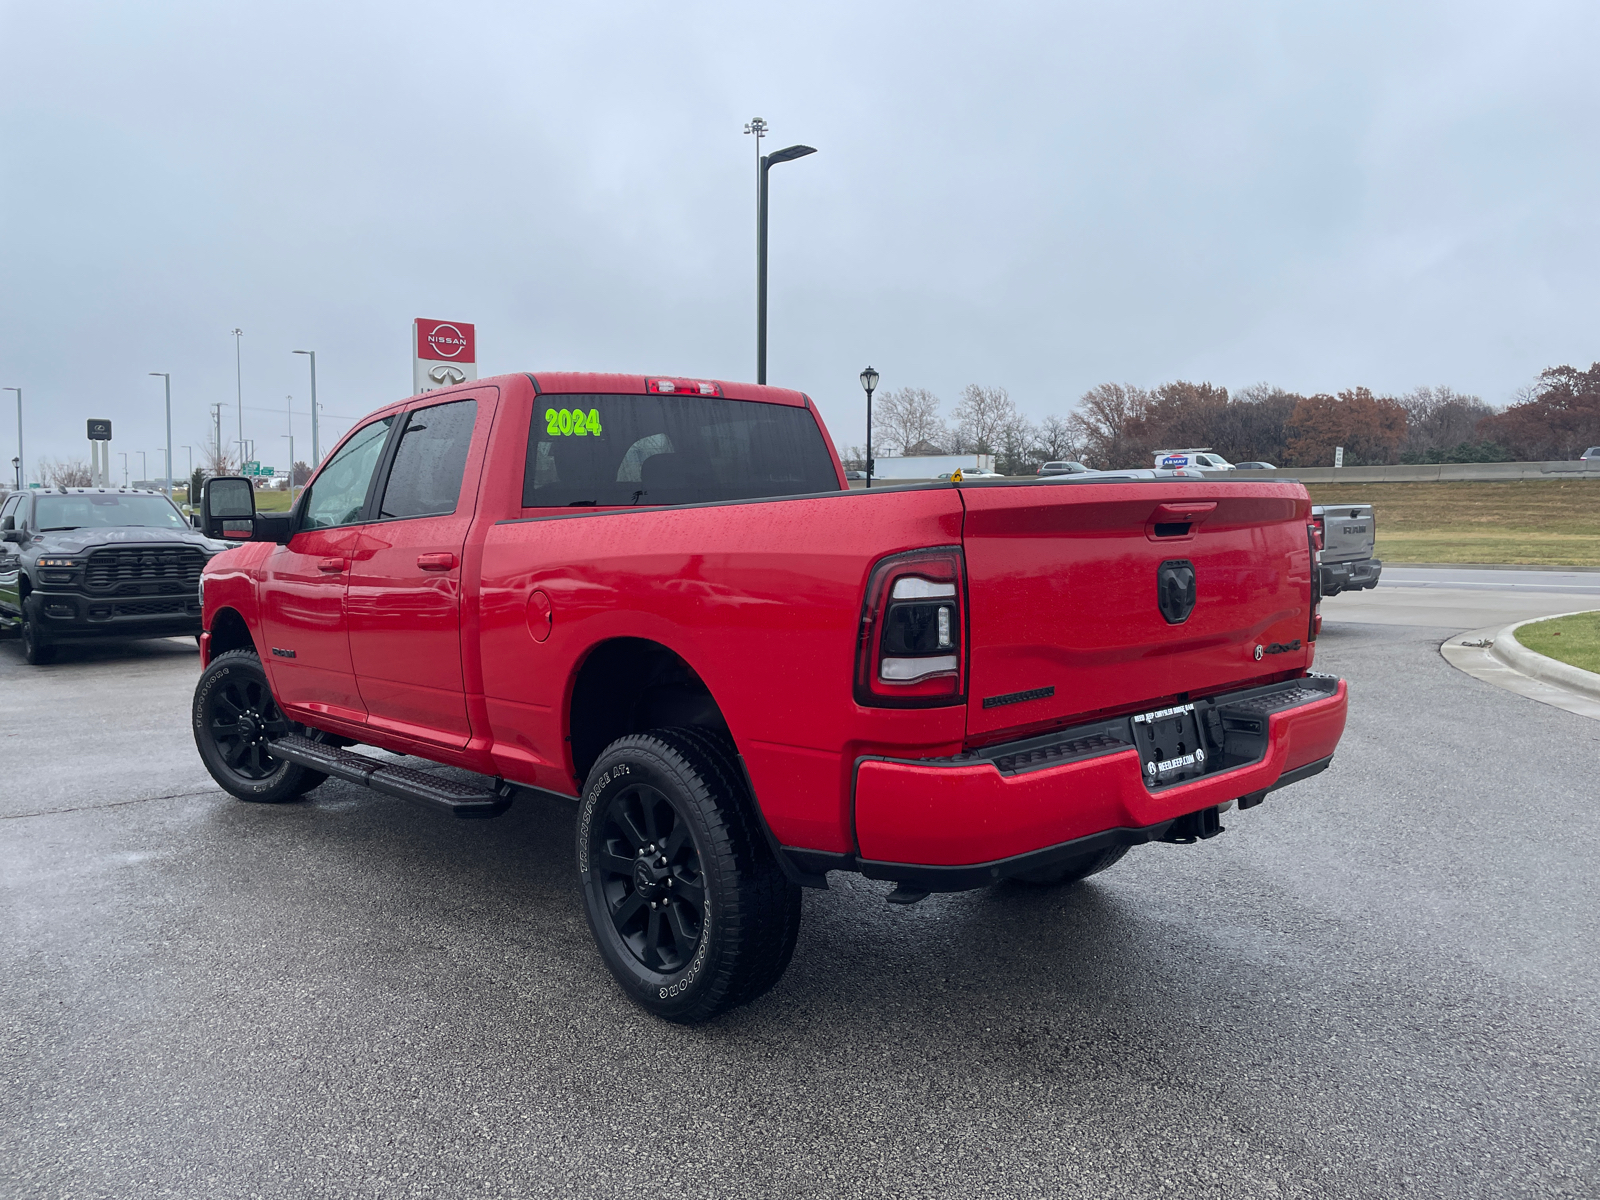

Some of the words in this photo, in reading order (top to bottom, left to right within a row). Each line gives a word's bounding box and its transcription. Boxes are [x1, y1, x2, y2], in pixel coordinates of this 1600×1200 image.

[427, 335, 467, 346] NISSAN
[545, 408, 602, 437] 2024
[1343, 525, 1367, 535] RAM
[119, 556, 180, 565] RAM
[272, 647, 297, 658] RAM
[580, 772, 611, 873] TRANSFORCE
[659, 900, 711, 999] Firestone
